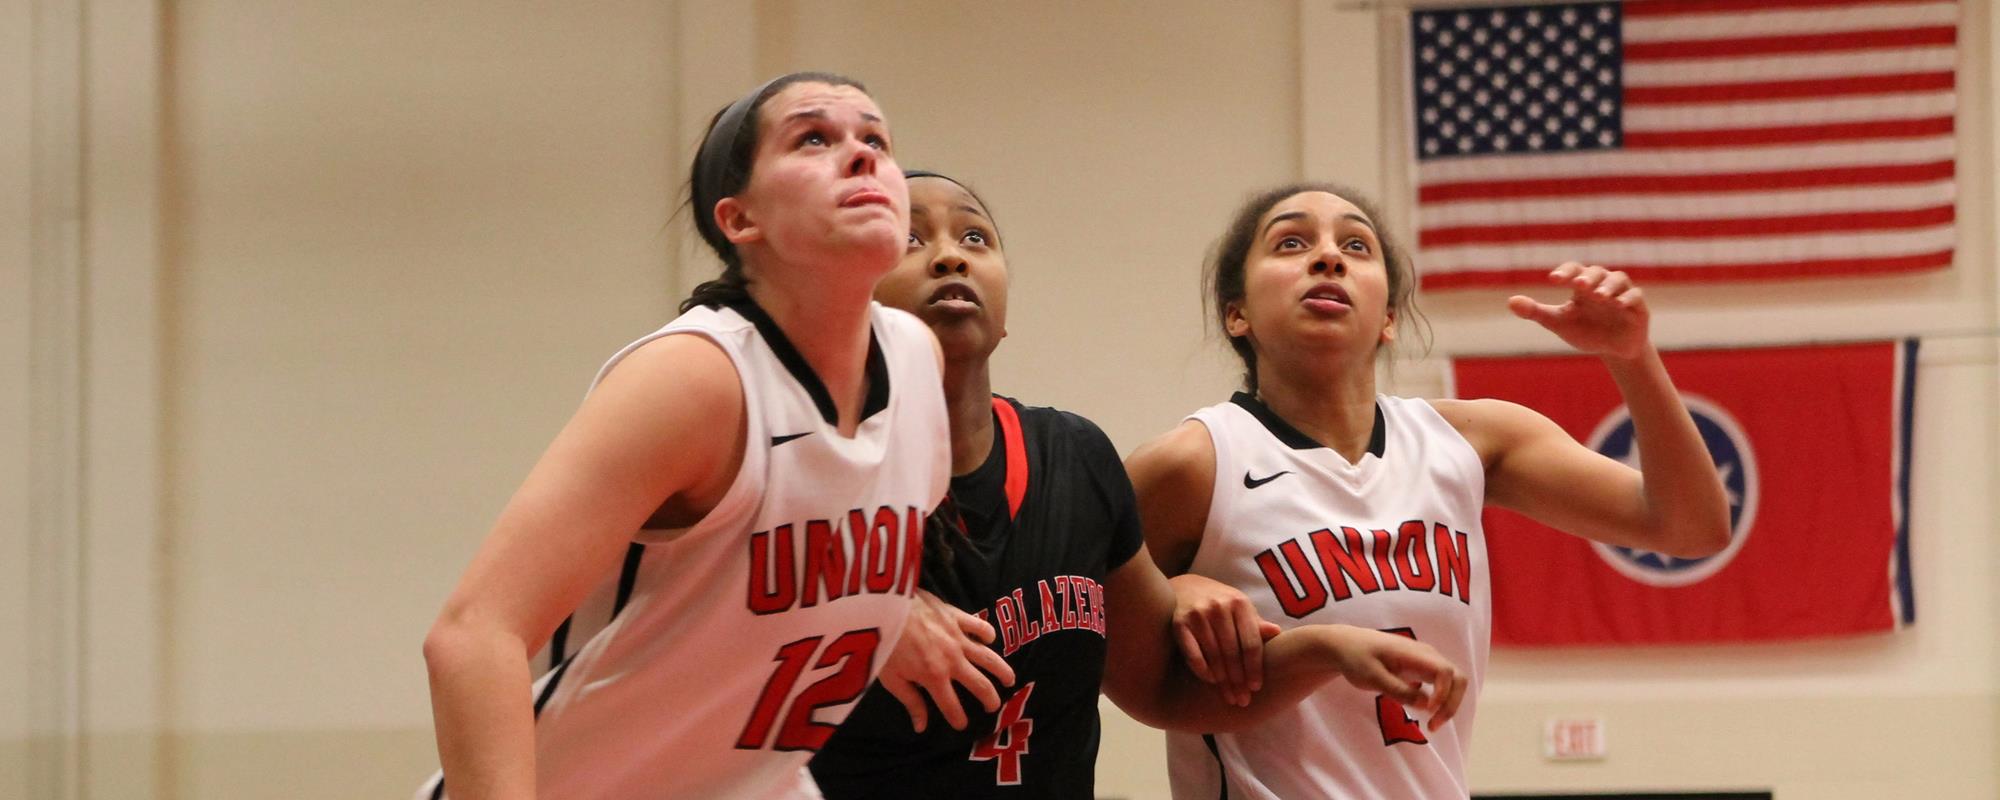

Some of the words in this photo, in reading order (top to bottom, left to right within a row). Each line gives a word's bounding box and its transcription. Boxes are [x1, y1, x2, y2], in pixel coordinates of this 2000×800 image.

[1254, 520, 1470, 619] UNION
[734, 627, 881, 752] 12
[969, 681, 1036, 786] 4
[1553, 720, 1597, 756] EXIT
